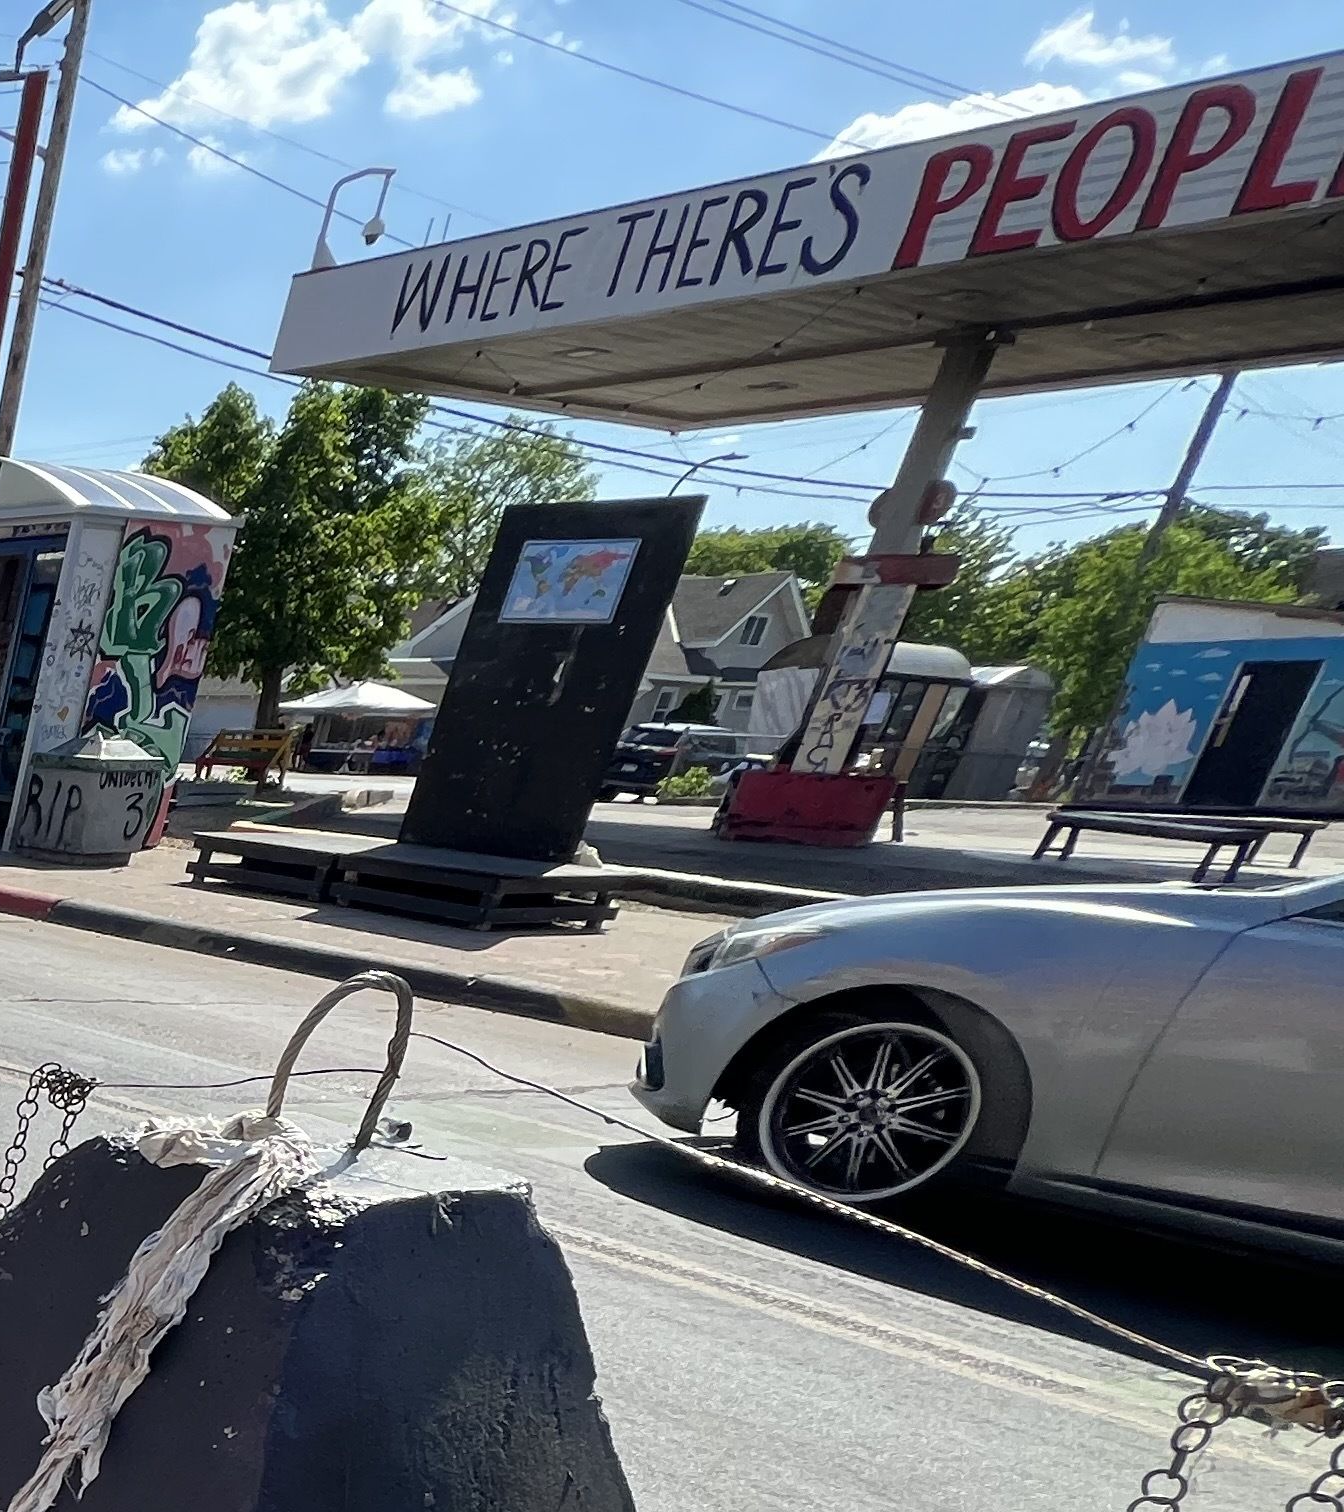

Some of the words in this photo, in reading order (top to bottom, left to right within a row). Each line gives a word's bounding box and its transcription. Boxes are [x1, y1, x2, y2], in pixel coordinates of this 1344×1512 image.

[388, 225, 593, 334] WHERE
[606, 161, 871, 298] THERE'S
[890, 66, 1344, 272] PEOPL
[19, 773, 82, 849] RIP
